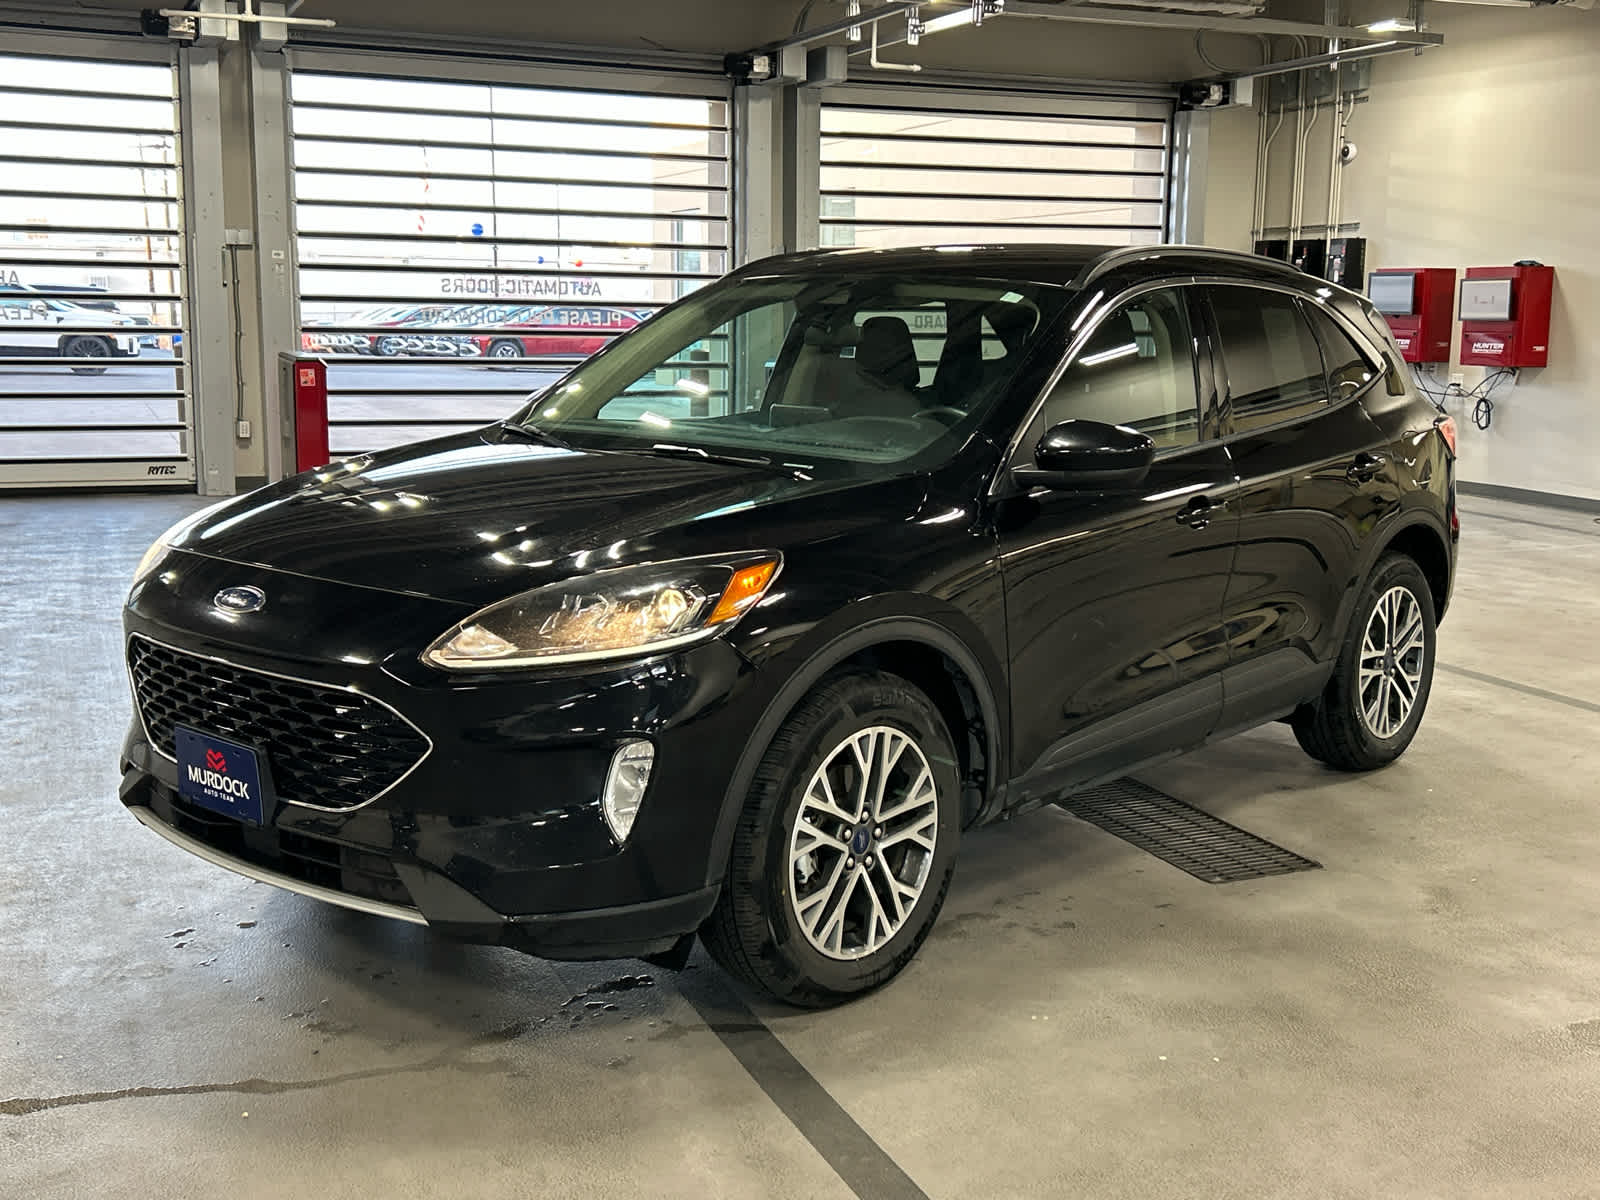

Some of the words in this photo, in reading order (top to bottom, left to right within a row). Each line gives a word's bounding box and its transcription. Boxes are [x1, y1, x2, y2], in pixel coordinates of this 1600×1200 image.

[1472, 342, 1505, 351] HUNTER
[147, 465, 176, 475] RYTEC
[187, 764, 250, 800] MURDOCK
[203, 787, 219, 798] AUTO
